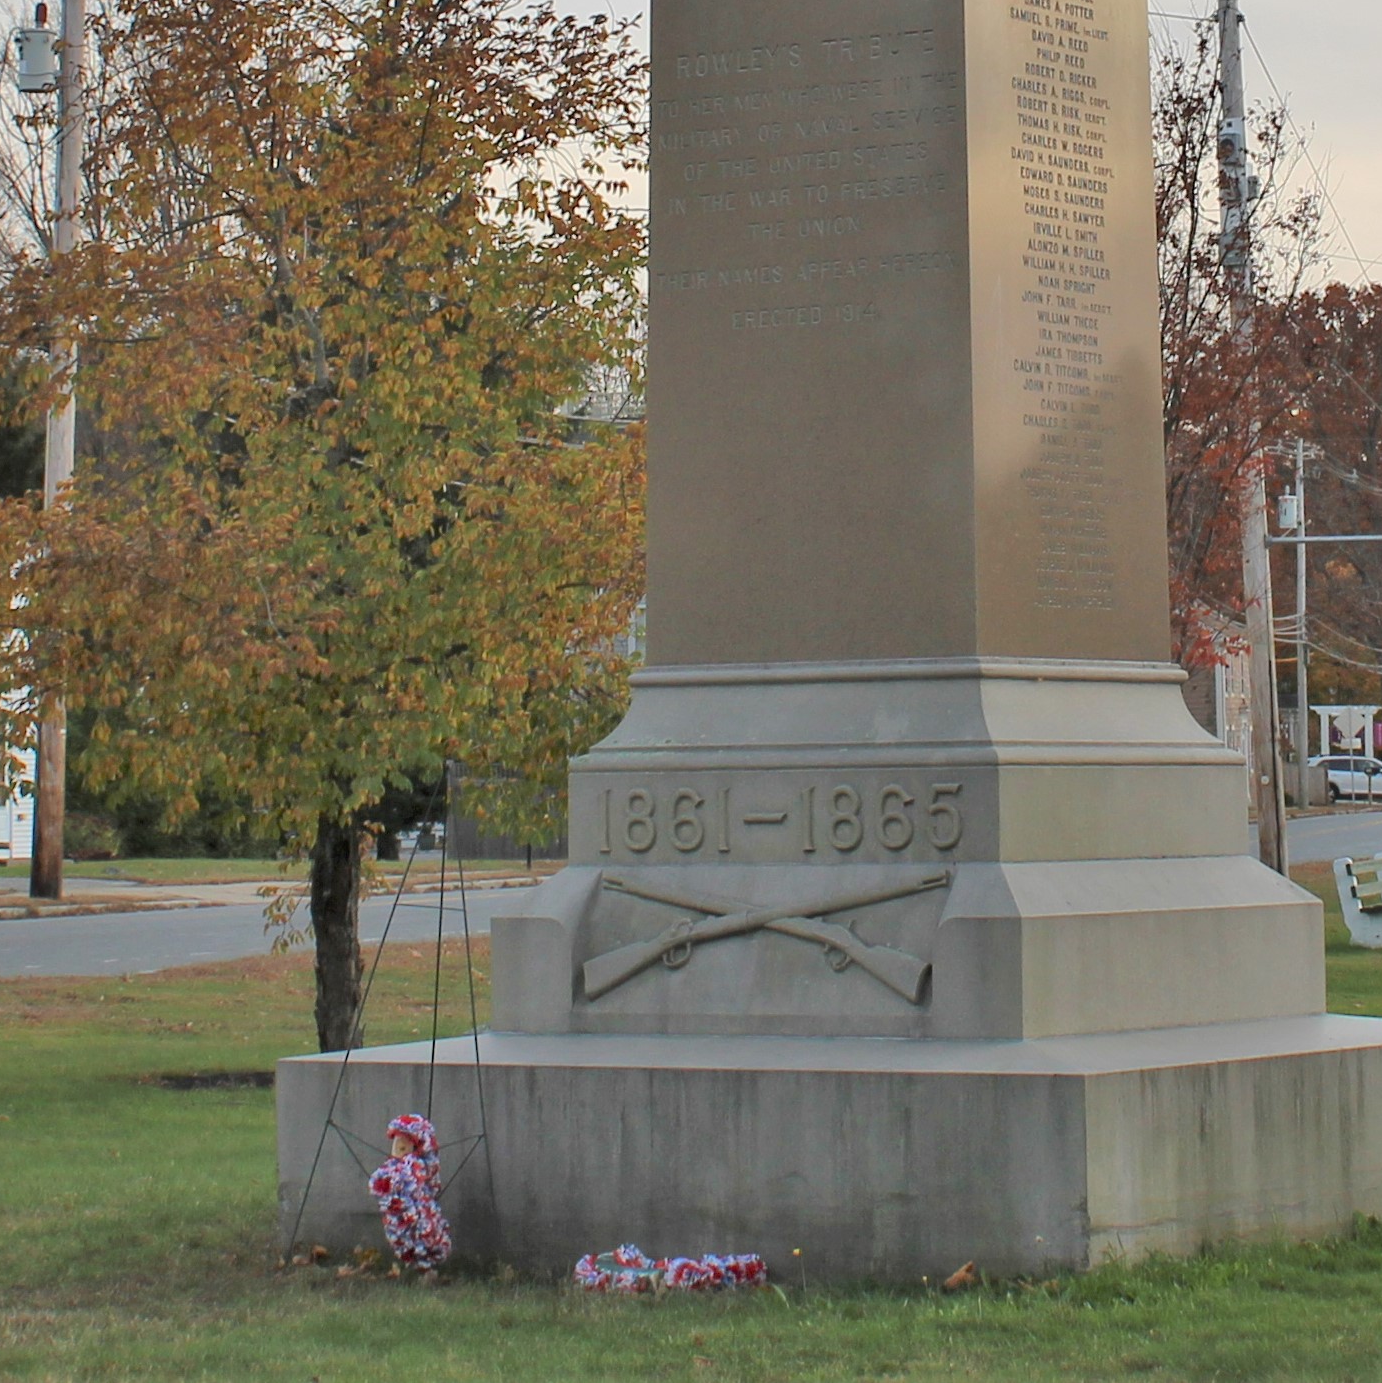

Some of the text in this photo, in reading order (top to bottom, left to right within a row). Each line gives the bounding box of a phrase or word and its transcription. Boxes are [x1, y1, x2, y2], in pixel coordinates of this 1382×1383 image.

[1010, 7, 1042, 26] SAMUEL
[1065, 3, 1094, 21] POTTER
[1032, 29, 1055, 45] DAVID
[1068, 38, 1089, 53] REED
[677, 29, 934, 78] ROWLEY'S TRIBUTE
[1037, 48, 1085, 69] PHILIP REED
[1011, 77, 1047, 95] CHARLES
[1025, 62, 1056, 79] ROBERT
[1069, 72, 1097, 89] RICKER
[657, 99, 679, 118] TO
[688, 95, 725, 116] HER
[732, 90, 774, 111] MEN
[778, 84, 820, 107] WHO
[830, 79, 883, 103] WERE
[921, 71, 957, 94] THE
[1017, 95, 1048, 113] ROBERT
[658, 104, 957, 151] MILITARY OR NAVAL SERVICE
[1017, 113, 1049, 131] THOMAS
[1011, 146, 1034, 163] DAVID
[1021, 132, 1057, 150] CHARLES
[1073, 142, 1104, 159] ROGERS
[684, 141, 928, 182] OF THE UNITED STATES
[1020, 166, 1054, 184] EDWARD
[1067, 175, 1108, 194] SAUNDERS
[667, 173, 945, 217] IN THE WAR TO PRESERVE
[1023, 185, 1050, 200] MOSES
[1064, 191, 1104, 210] SAUNDERS
[1024, 202, 1059, 219] CHARLES
[1073, 211, 1105, 228] SAWYER
[747, 214, 858, 242] THE UNION
[1075, 229, 1098, 244] SMITH
[1027, 238, 1059, 255] ALONZO
[1073, 246, 1105, 263] SPILLER
[656, 269, 708, 292] THEIR
[718, 263, 784, 287] NAMES
[797, 257, 868, 281] APPEAR
[1022, 255, 1056, 271] WILLIAM
[1079, 265, 1111, 281] SPILLER
[1038, 275, 1060, 289] NOAH
[1021, 291, 1043, 304] JOHN
[732, 301, 876, 330] ERECTED 1914
[1037, 310, 1070, 326] WILLIAM
[1057, 330, 1099, 347] THOMPSON
[1035, 345, 1062, 360] JAMES
[1013, 358, 1041, 374] CALVIN
[1023, 379, 1044, 392] JOHN
